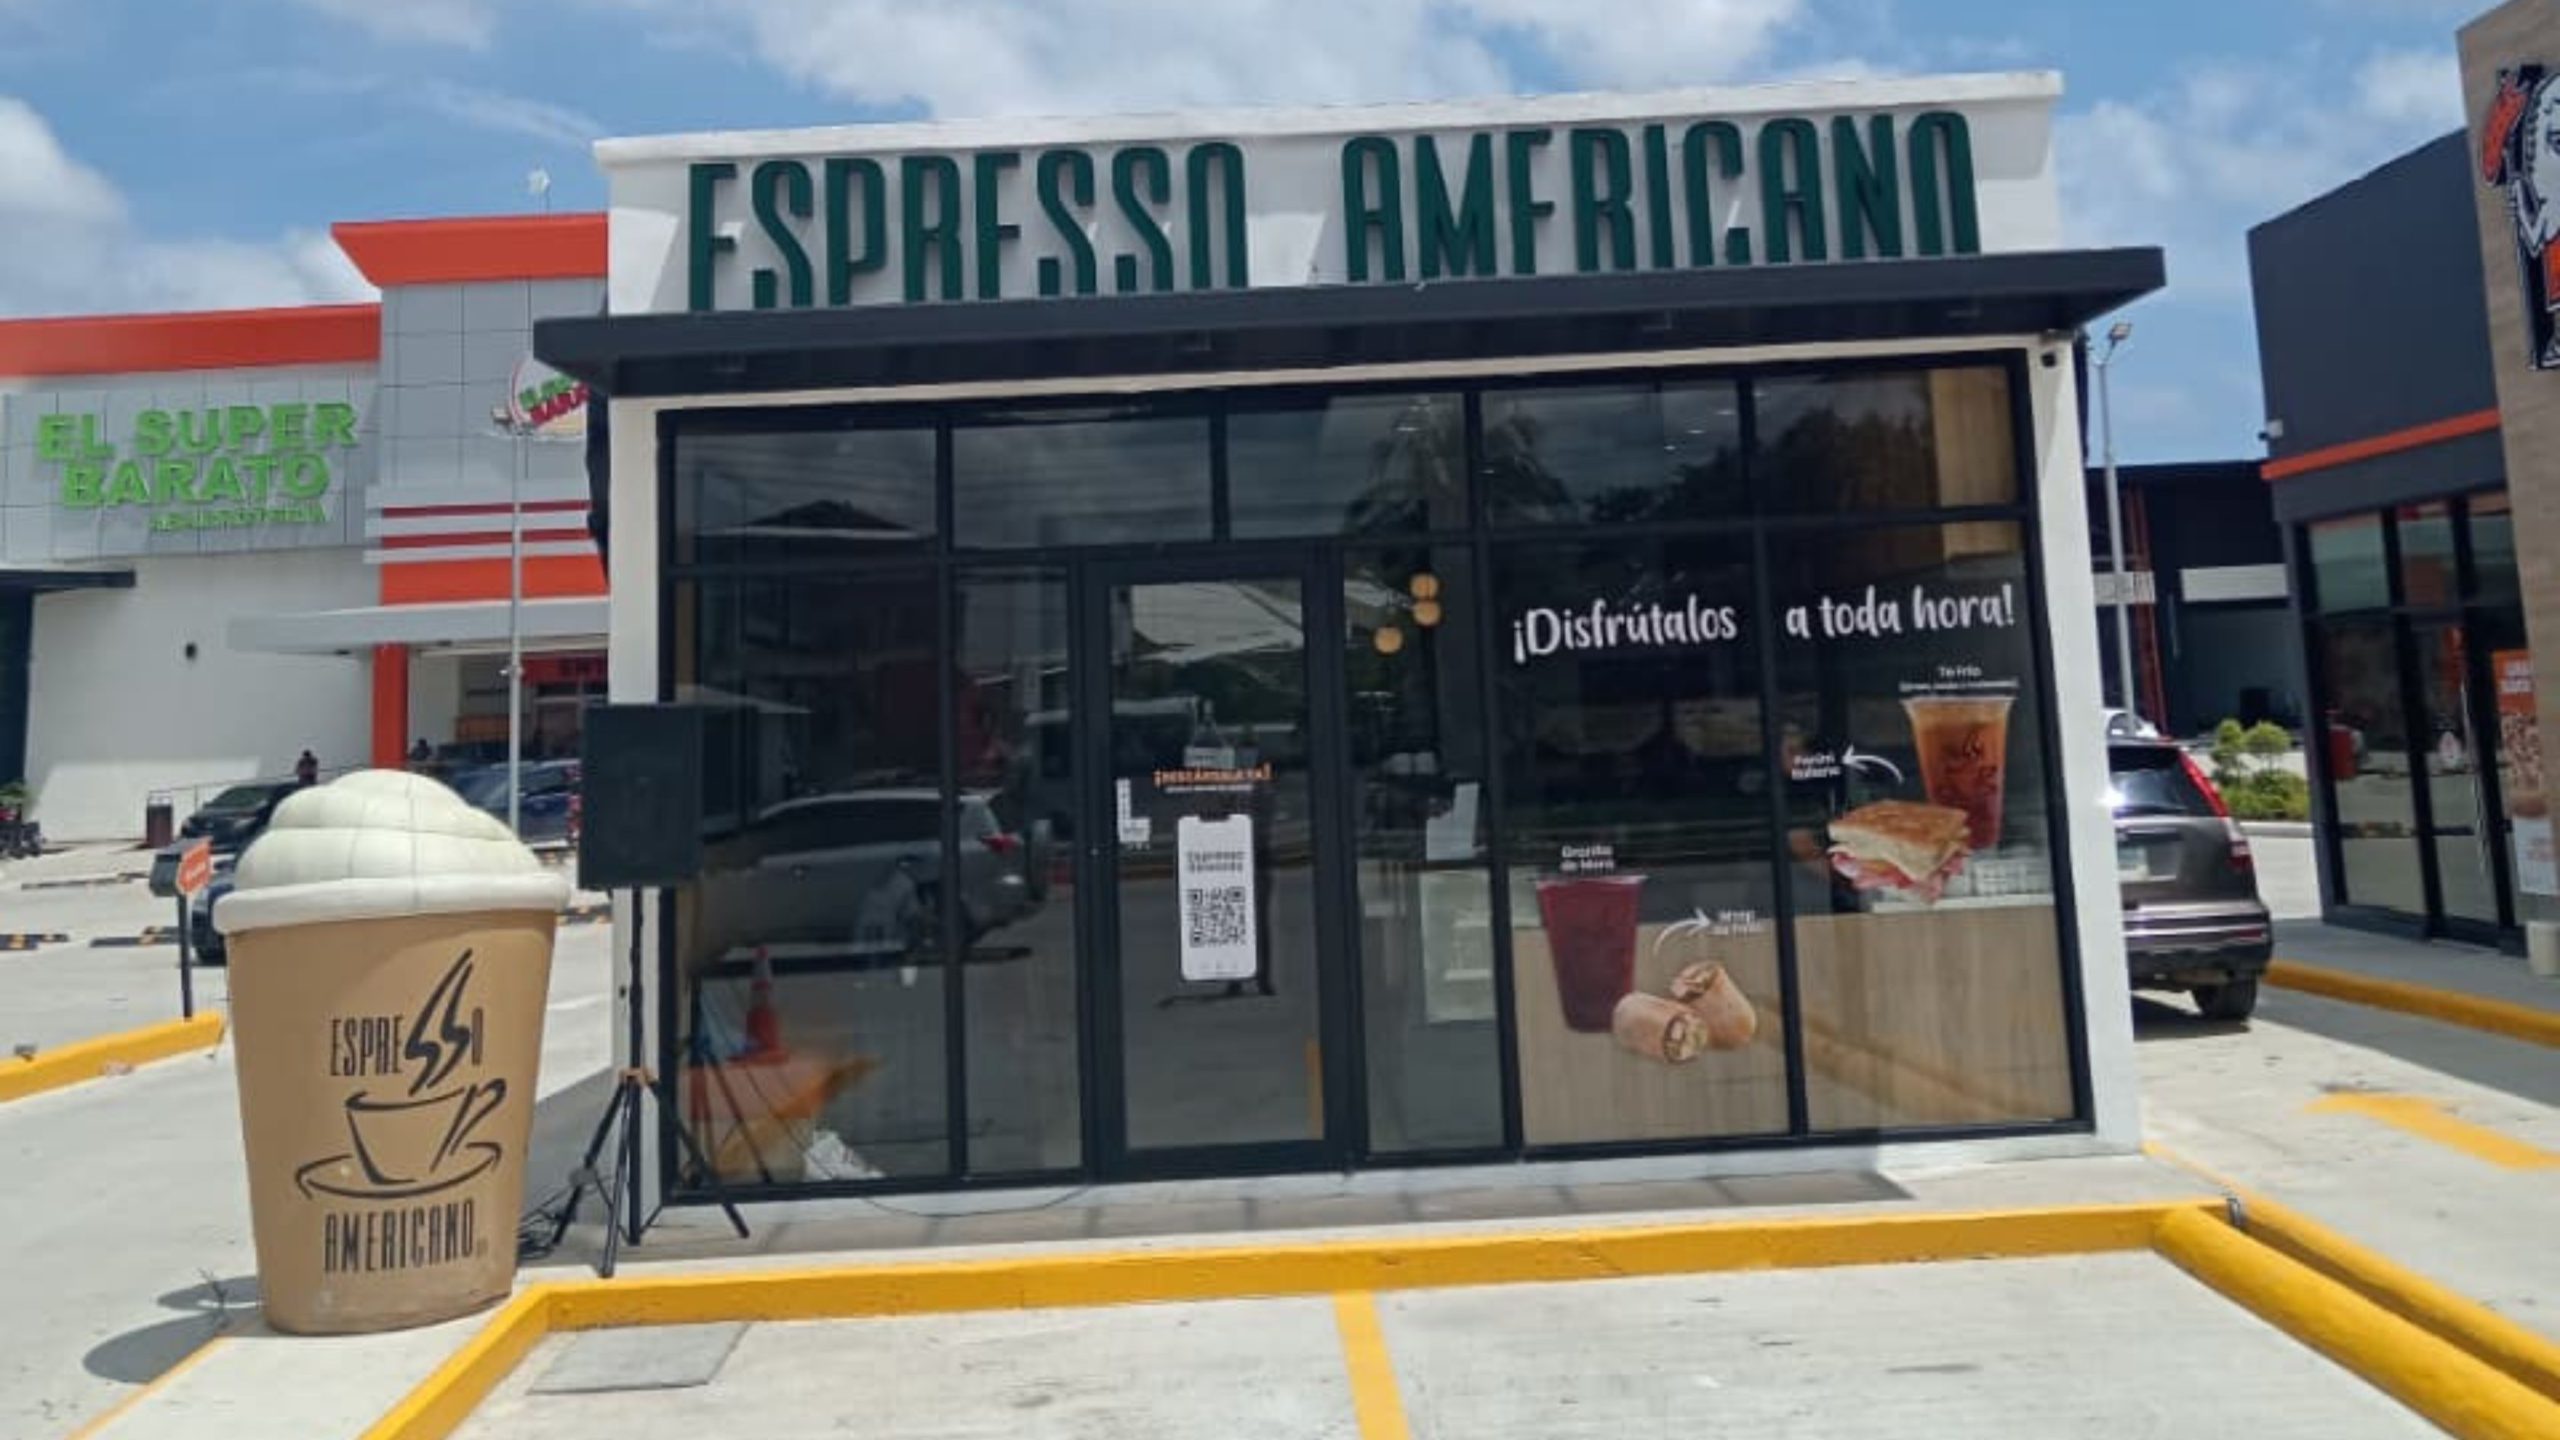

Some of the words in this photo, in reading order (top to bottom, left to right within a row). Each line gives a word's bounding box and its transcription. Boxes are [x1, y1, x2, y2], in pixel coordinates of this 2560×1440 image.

[689, 142, 1248, 310] ESPRESSO
[1341, 110, 1980, 282] AMERICANO
[36, 413, 113, 458] EL
[134, 403, 358, 456] SUPER
[63, 452, 329, 508] BARATO
[1513, 594, 1737, 663] ¡Disfrútalos
[1786, 604, 1810, 640] a
[1817, 585, 1901, 638] toda
[1912, 582, 2016, 630] hora!
[324, 1198, 474, 1274] AMERICANO
